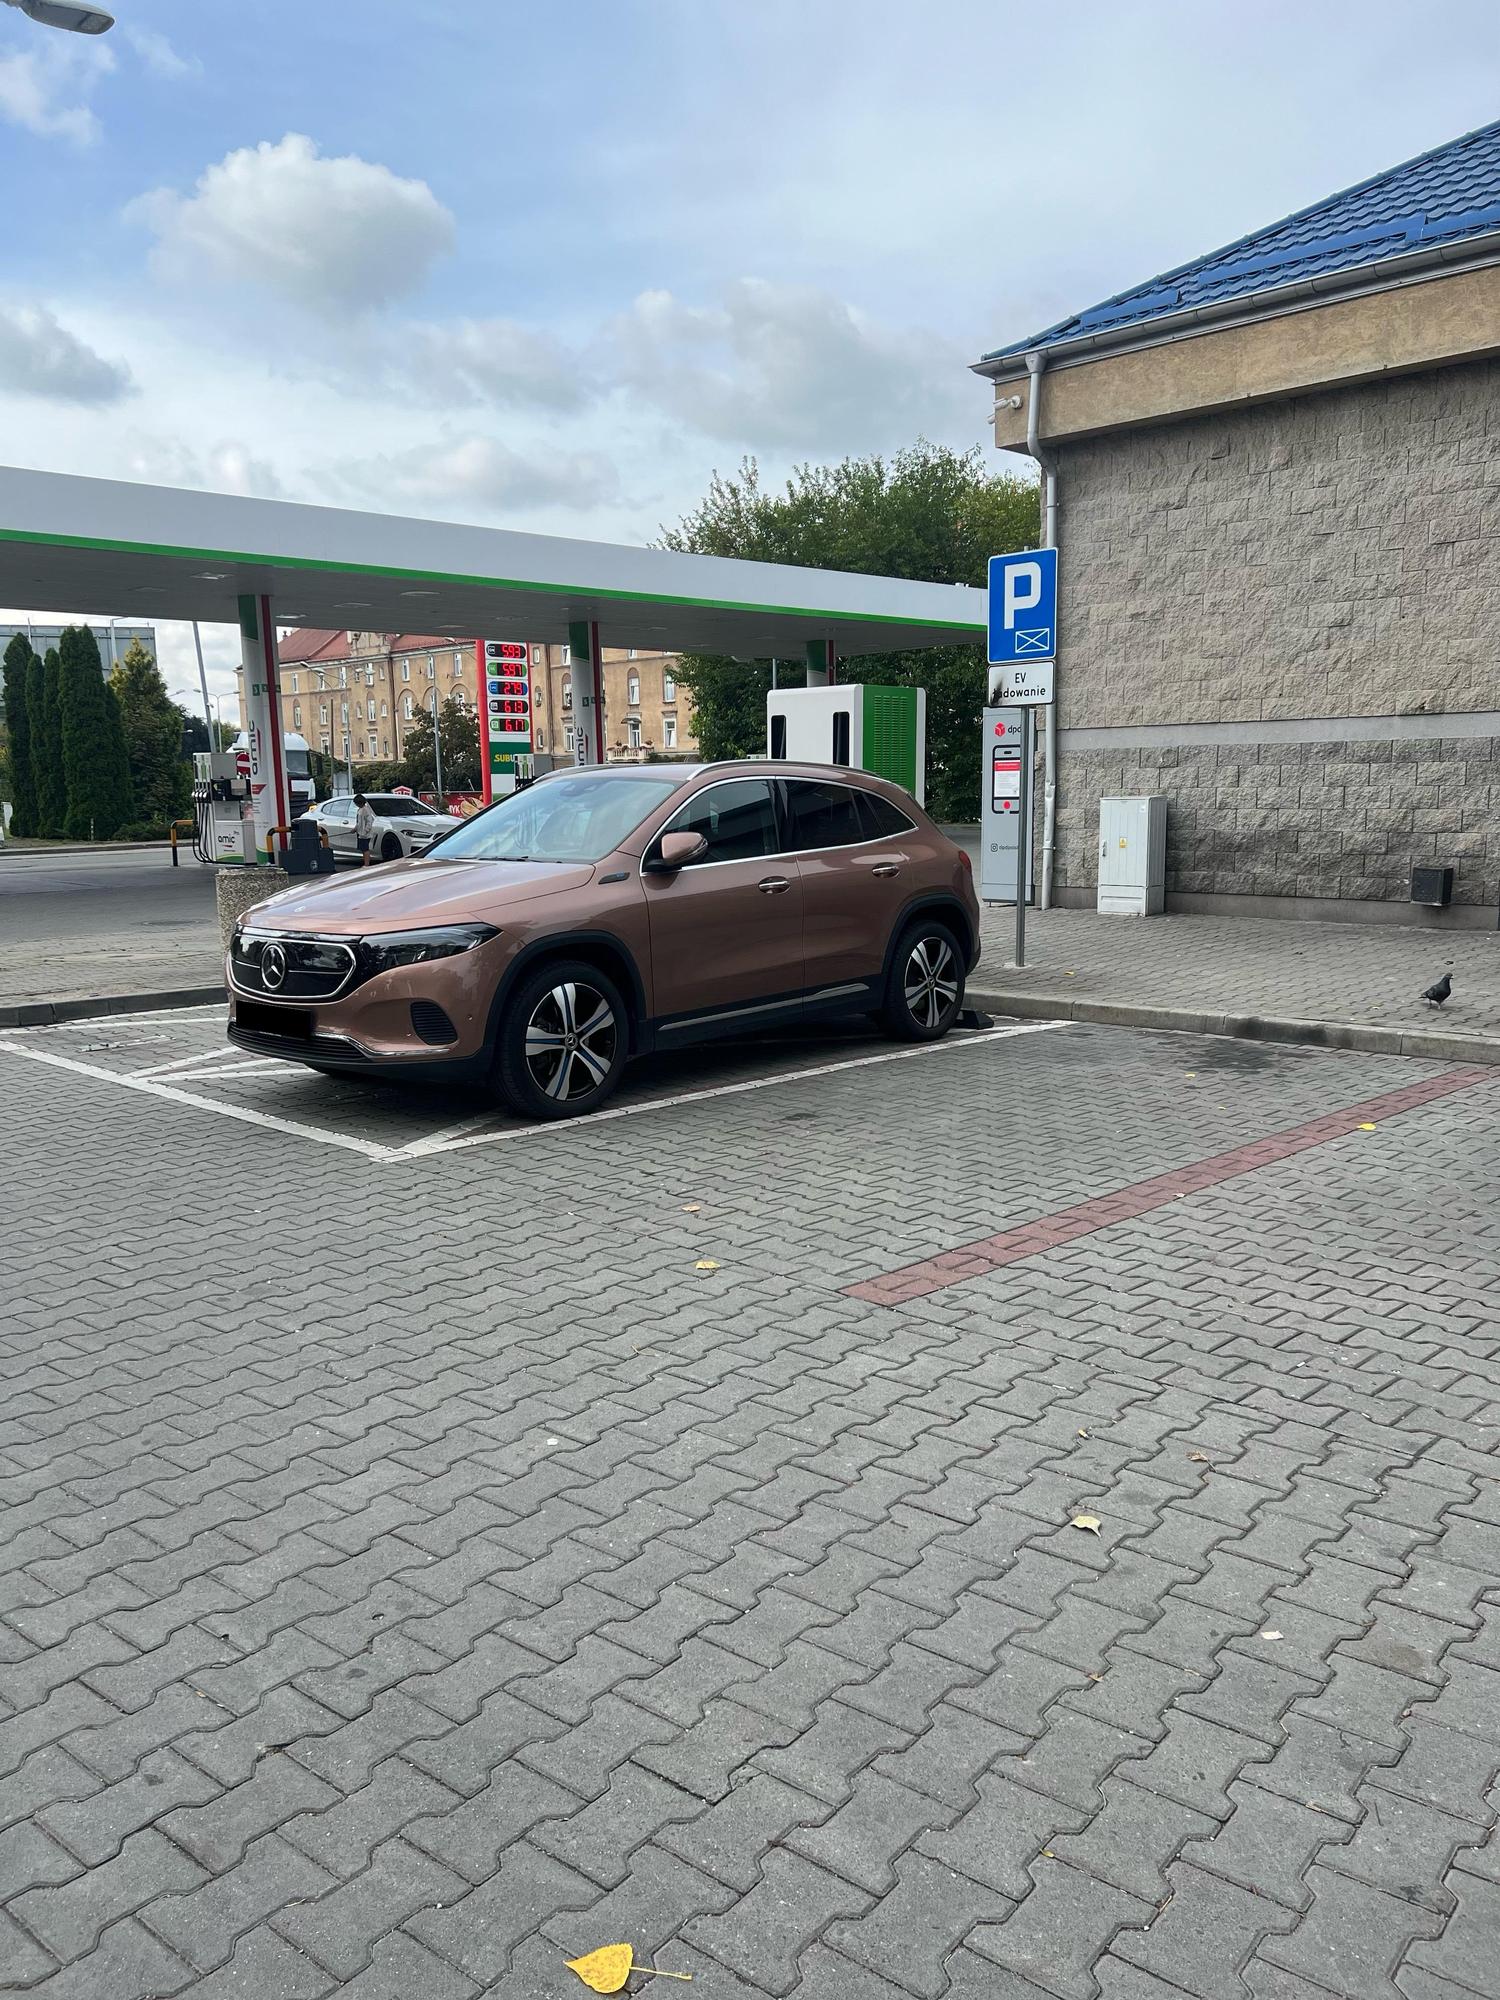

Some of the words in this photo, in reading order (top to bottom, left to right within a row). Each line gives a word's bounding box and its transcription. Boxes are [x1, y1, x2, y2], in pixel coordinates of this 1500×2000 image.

[1004, 561, 1041, 629] P
[1015, 672, 1026, 683] EV
[494, 754, 514, 763] SUB
[217, 833, 235, 844] amic
